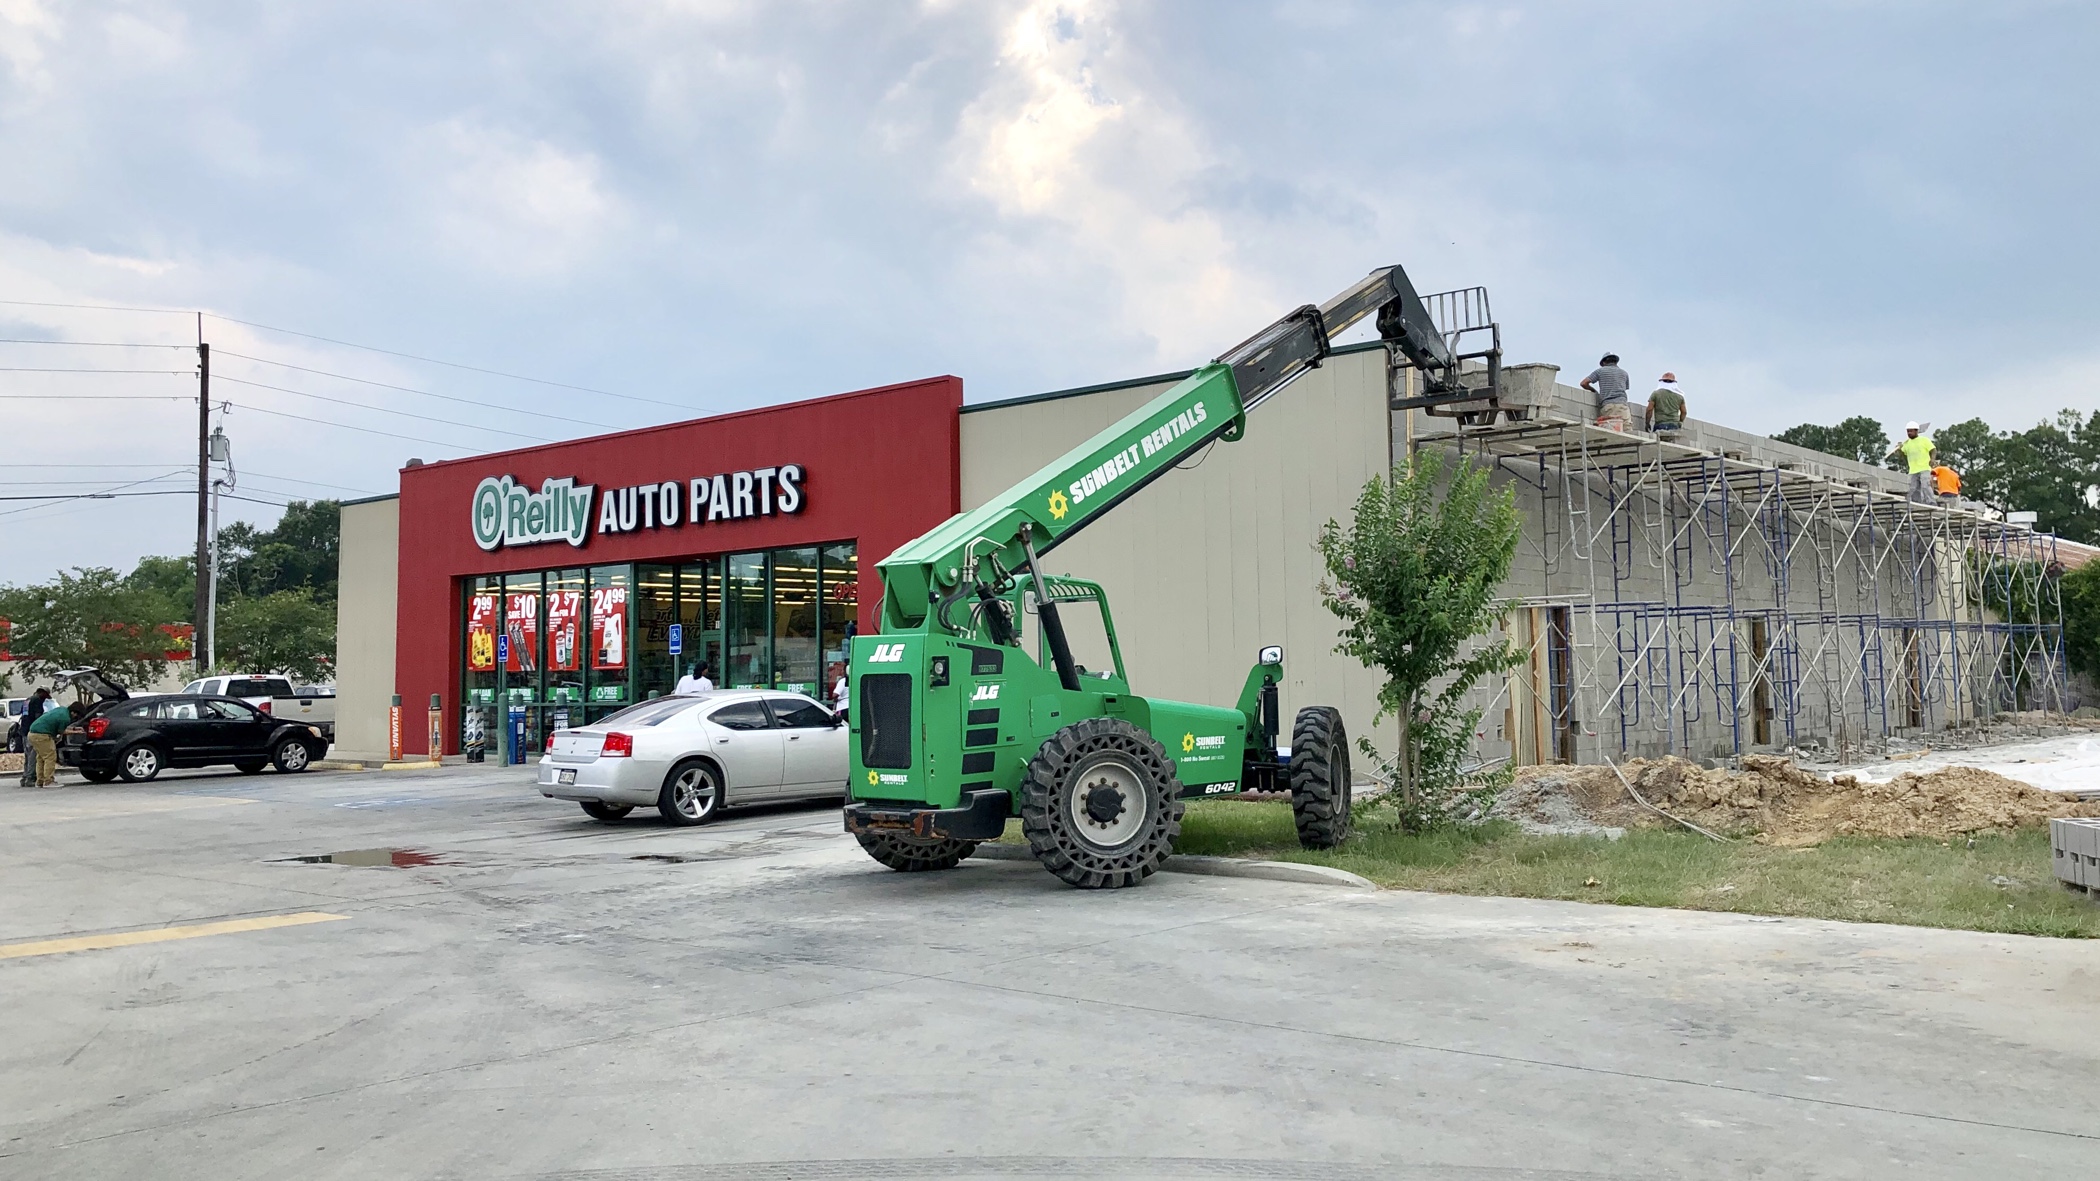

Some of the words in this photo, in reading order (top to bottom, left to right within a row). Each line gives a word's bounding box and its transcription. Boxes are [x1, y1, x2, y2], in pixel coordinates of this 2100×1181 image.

[1069, 442, 1141, 505] SUNBELT
[1140, 401, 1207, 459] RENTALS
[473, 480, 590, 545] O'Reilly
[598, 481, 679, 534] AUTO
[690, 464, 800, 523] PARTS
[833, 582, 858, 600] OPE
[514, 594, 536, 619] $10
[564, 592, 580, 617] $7
[868, 643, 906, 663] JLG
[603, 686, 618, 695] FREE
[972, 684, 1000, 701] JLG
[391, 706, 400, 748] SYLVANIA
[1195, 735, 1226, 747] SUNBELT
[880, 773, 909, 783] SUNBELT
[1204, 781, 1236, 794] 6042
